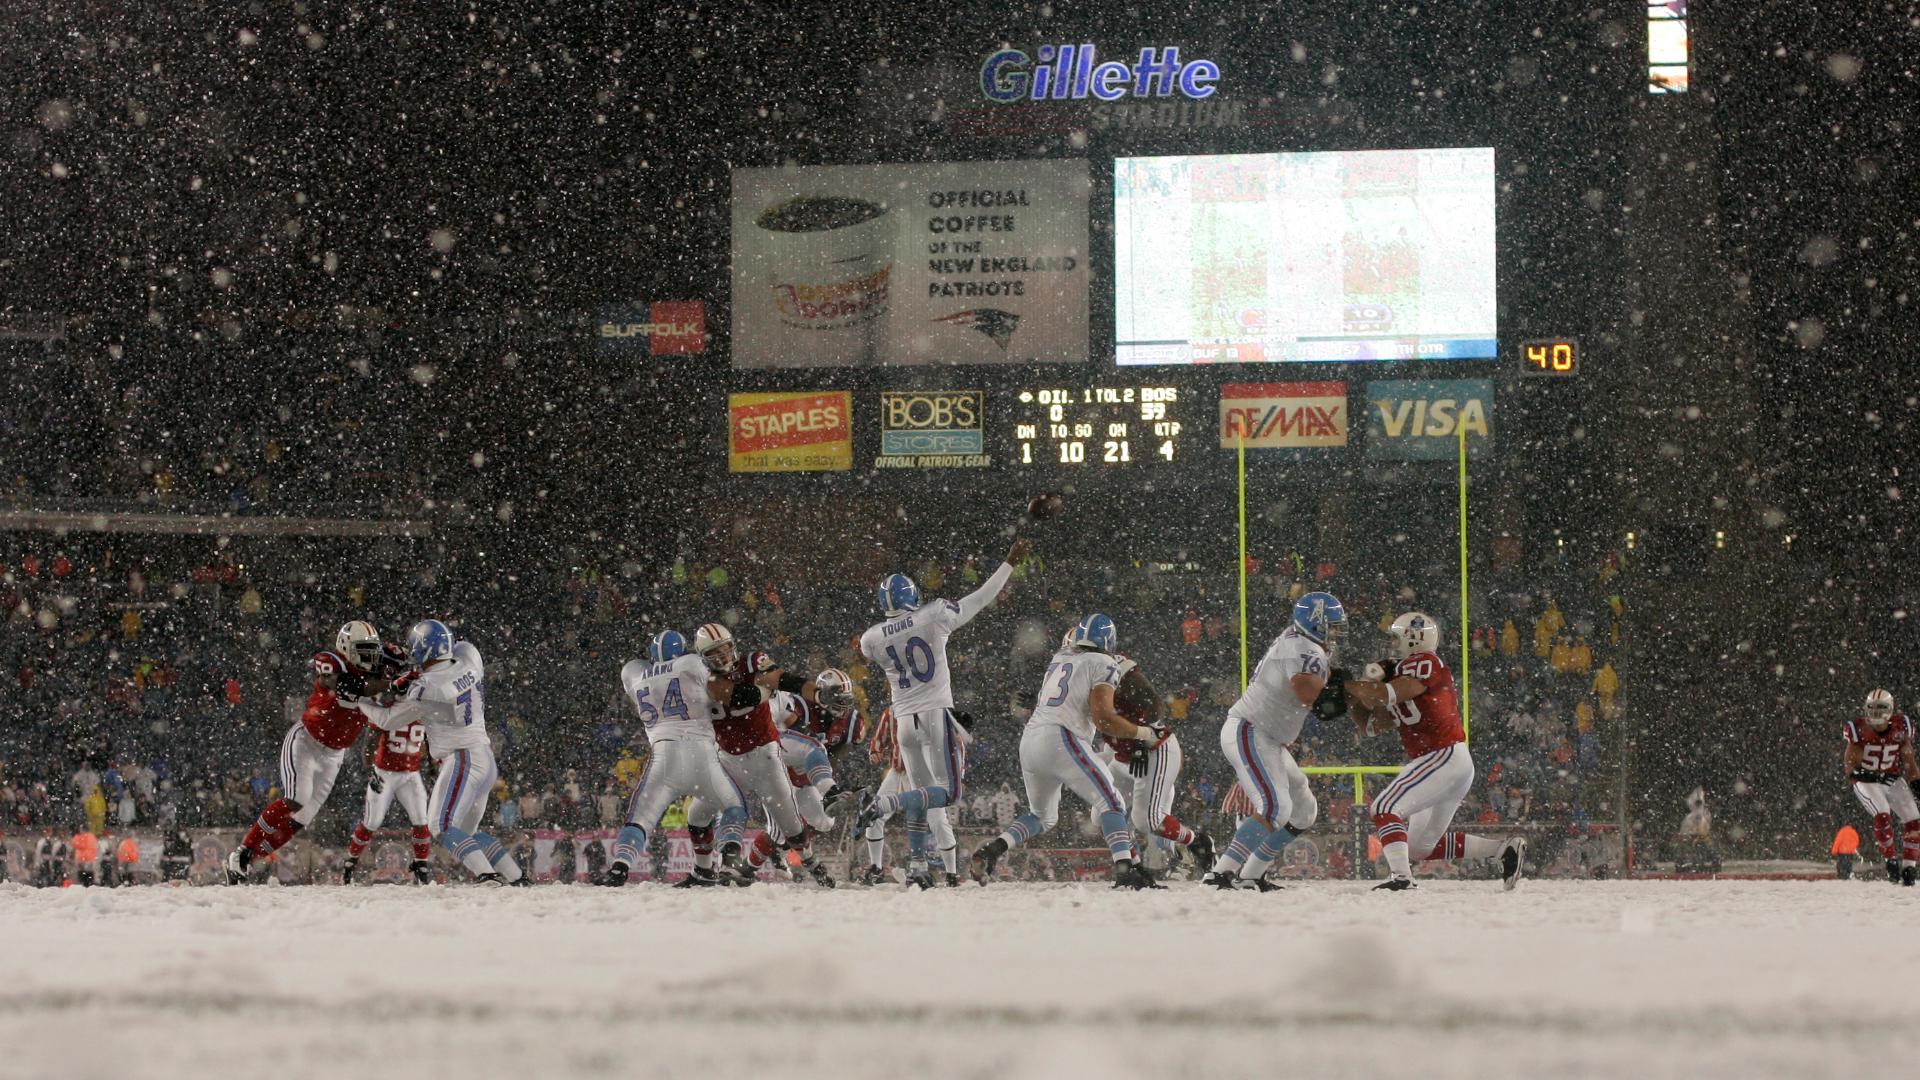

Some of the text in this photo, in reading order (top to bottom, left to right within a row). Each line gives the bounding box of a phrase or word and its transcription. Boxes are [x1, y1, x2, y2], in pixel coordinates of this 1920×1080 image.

[979, 44, 1221, 102] Gillette
[1090, 102, 1242, 130] STADIUM
[928, 190, 1030, 208] OFFICIAL
[928, 215, 1016, 233] COFFEE
[928, 241, 981, 253] OF THE
[928, 256, 1077, 274] NEW ENGLAND
[928, 281, 1025, 297] PATRIOTS
[601, 322, 699, 338] SUFFOLK
[1528, 344, 1571, 370] 40
[1123, 388, 1135, 403] 2
[1141, 387, 1178, 402] BOS
[889, 396, 976, 427] BOB'S
[1225, 405, 1340, 439] RE/MAX
[1374, 399, 1488, 437] VISA
[740, 406, 839, 439] STAPLES
[888, 435, 977, 450] STORES
[1022, 440, 1174, 464] 1 10 21 4
[743, 455, 768, 467] that
[774, 455, 800, 467] was
[874, 455, 992, 468] OFFICIAL PATRIOTS GEAR
[881, 616, 914, 637] YOUNG
[886, 636, 935, 689] 10
[1300, 654, 1321, 674] 76
[1402, 659, 1432, 680] 50
[453, 671, 475, 693] ROOS
[636, 677, 690, 728] 54
[387, 725, 427, 754] 59
[1861, 744, 1899, 770] 55
